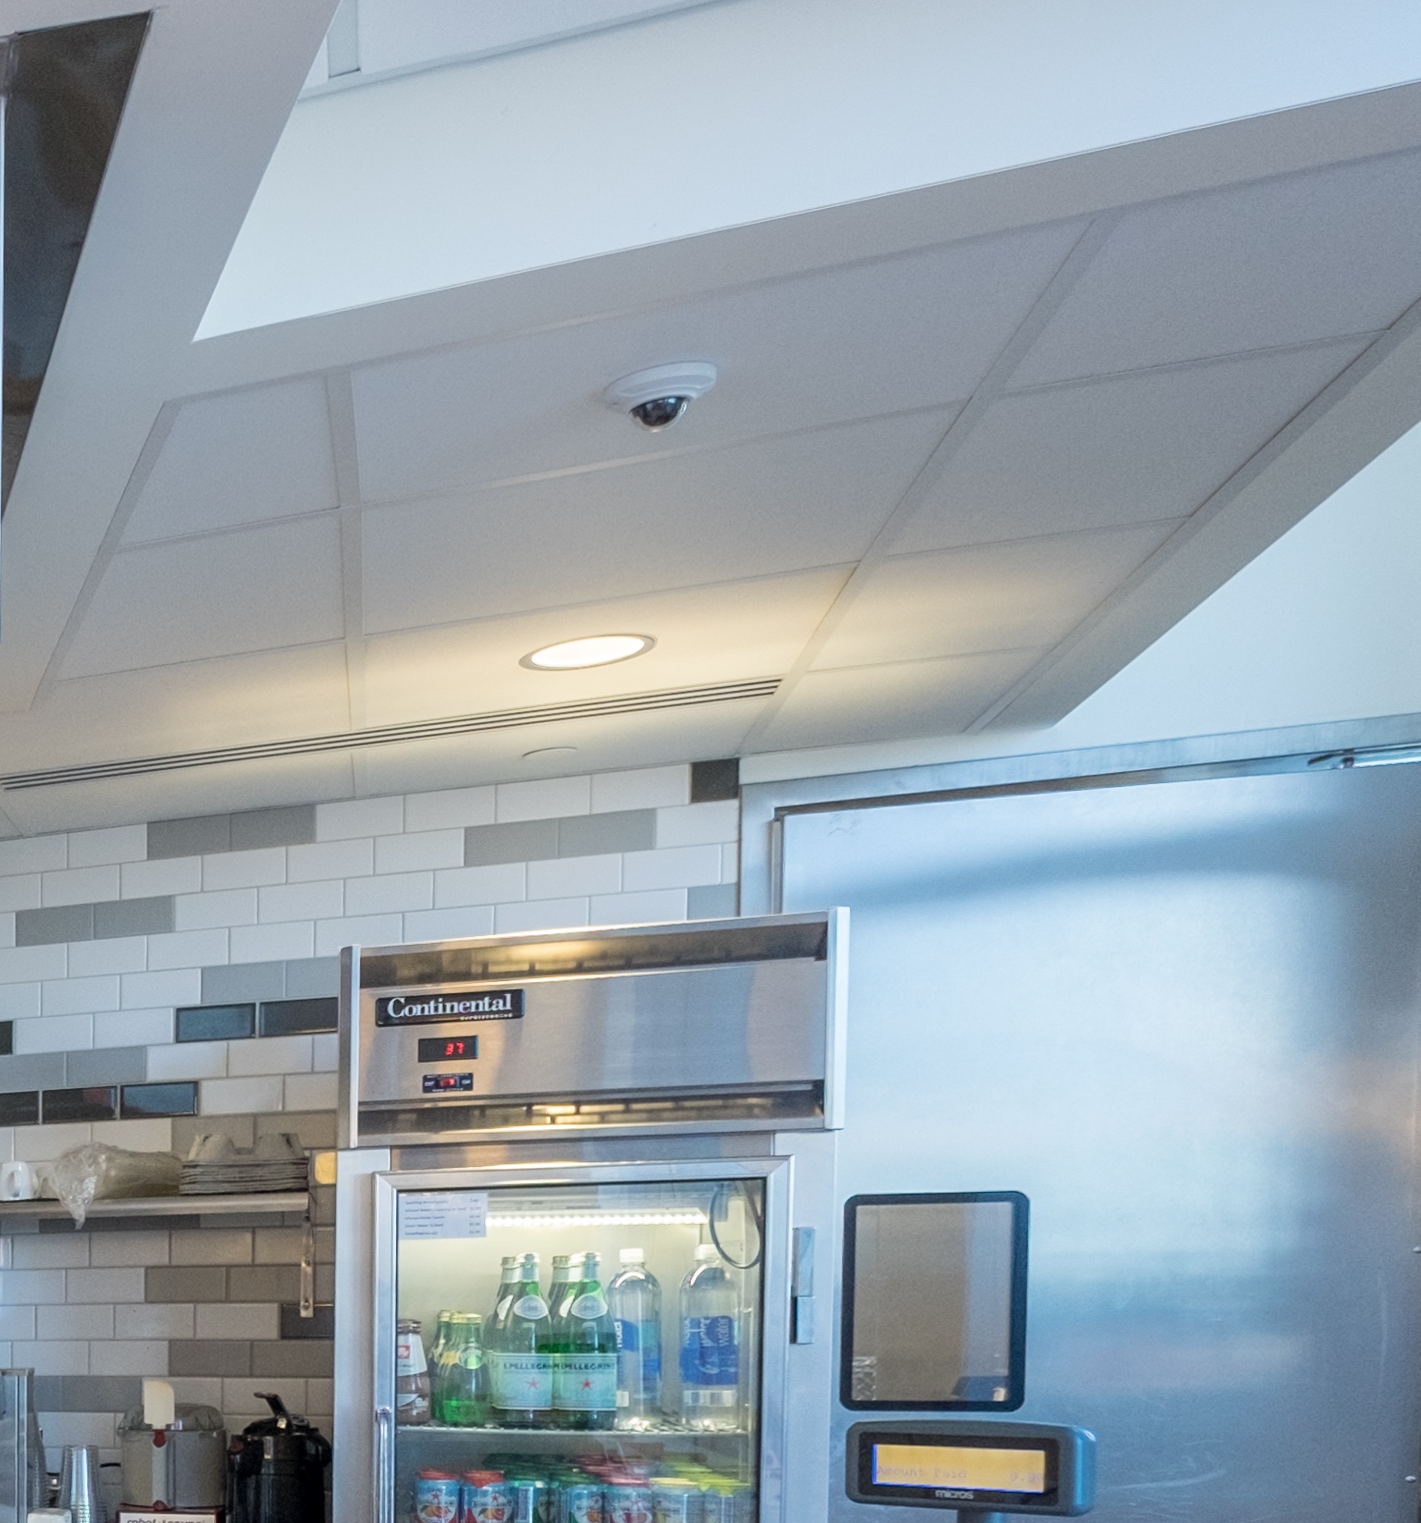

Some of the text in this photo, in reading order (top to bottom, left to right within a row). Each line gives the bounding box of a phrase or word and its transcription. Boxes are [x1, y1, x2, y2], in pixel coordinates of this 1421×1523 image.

[387, 993, 512, 1018] Continental
[877, 1465, 967, 1480] Amount Paid
[935, 1489, 974, 1500] micros
